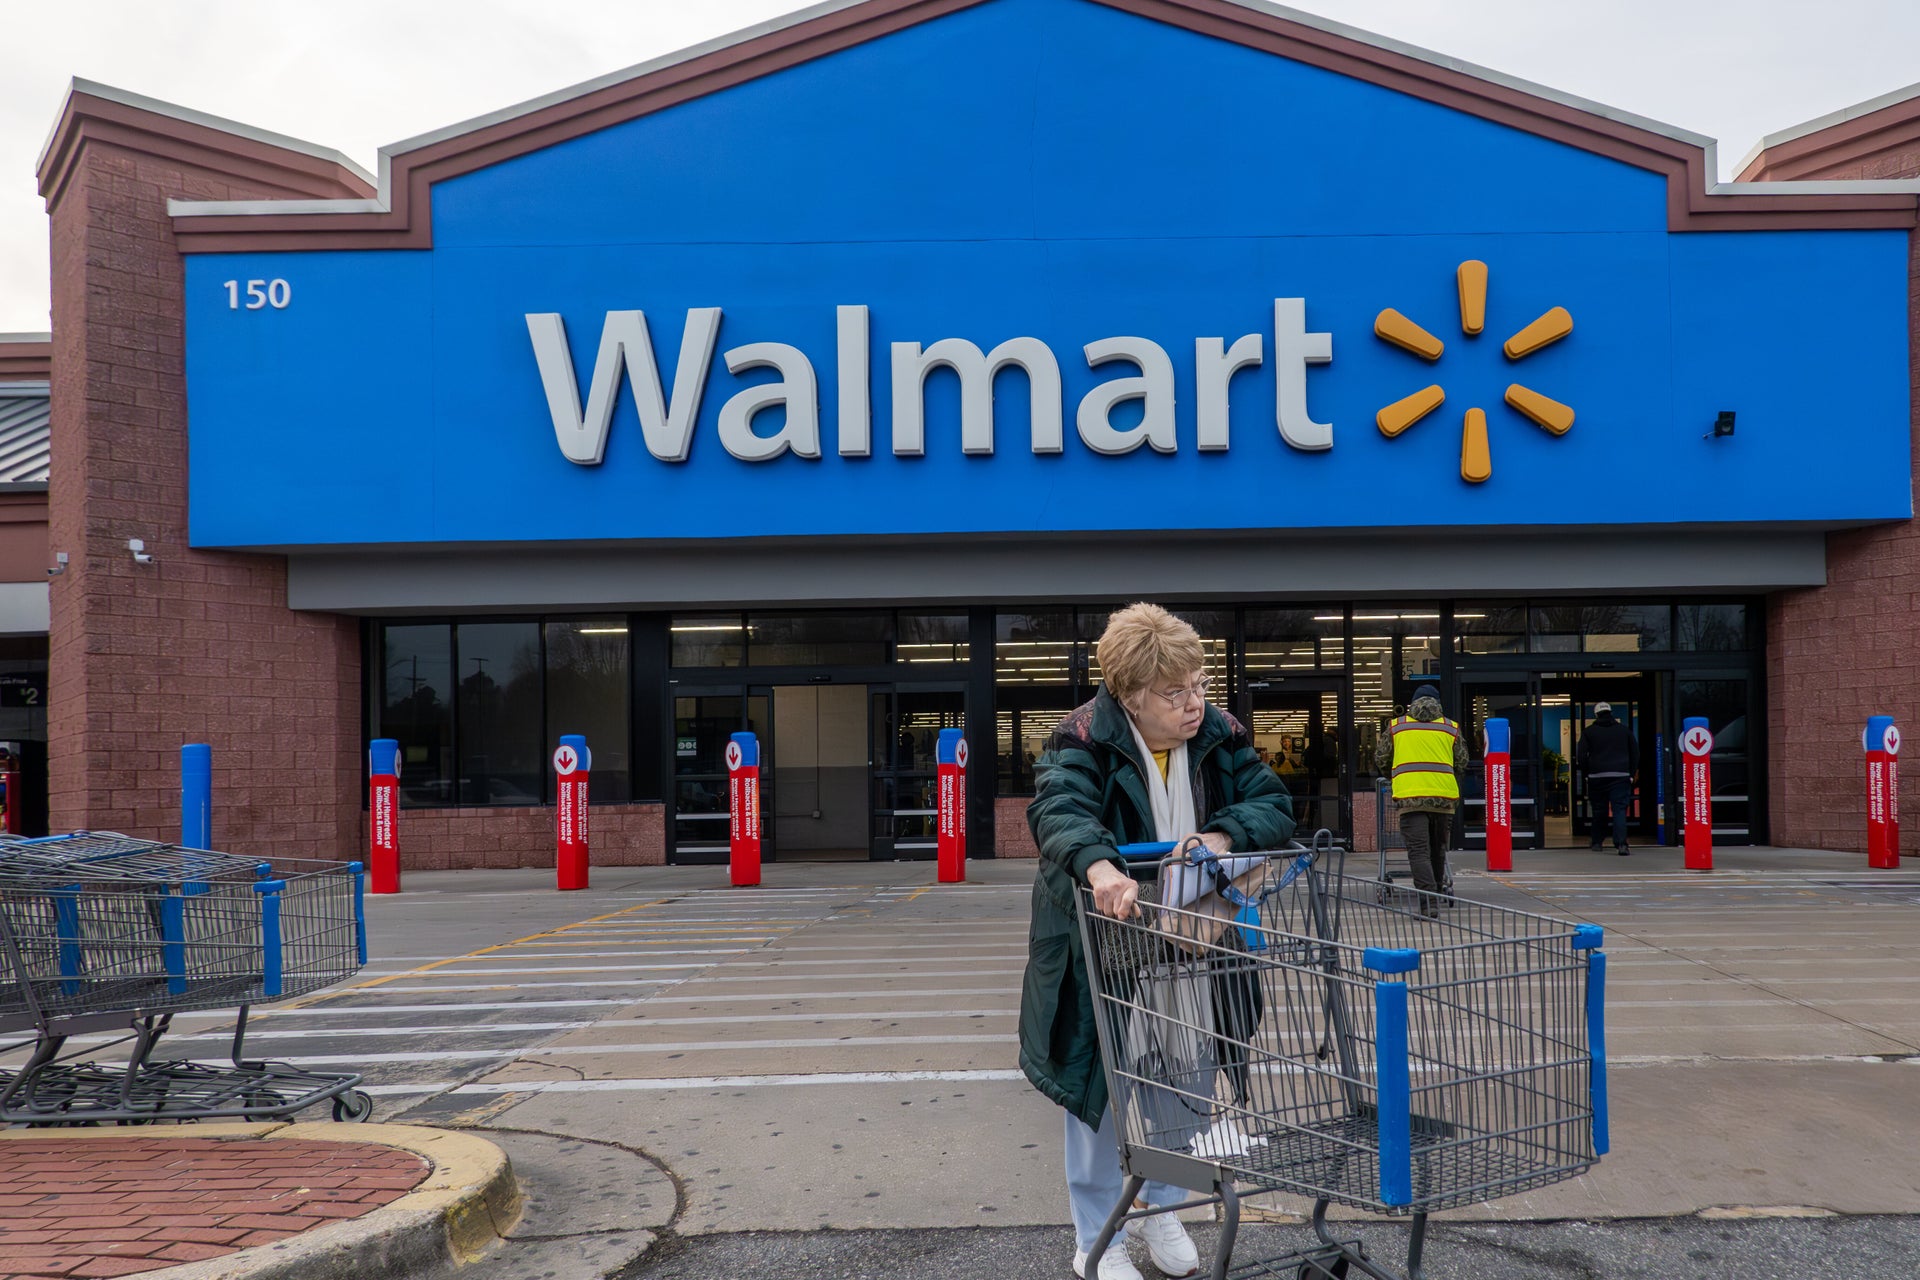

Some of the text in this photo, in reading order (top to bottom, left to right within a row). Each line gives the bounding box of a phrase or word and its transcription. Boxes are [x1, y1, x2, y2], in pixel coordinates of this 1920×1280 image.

[223, 278, 291, 309] 150
[525, 297, 1334, 465] Walmart
[383, 786, 391, 805] Wow!
[1500, 818, 1507, 826] of
[1701, 816, 1708, 825] of
[1877, 815, 1884, 824] of
[752, 831, 758, 840] of
[947, 829, 954, 837] of
[384, 841, 392, 849] of
[566, 836, 573, 845] of
